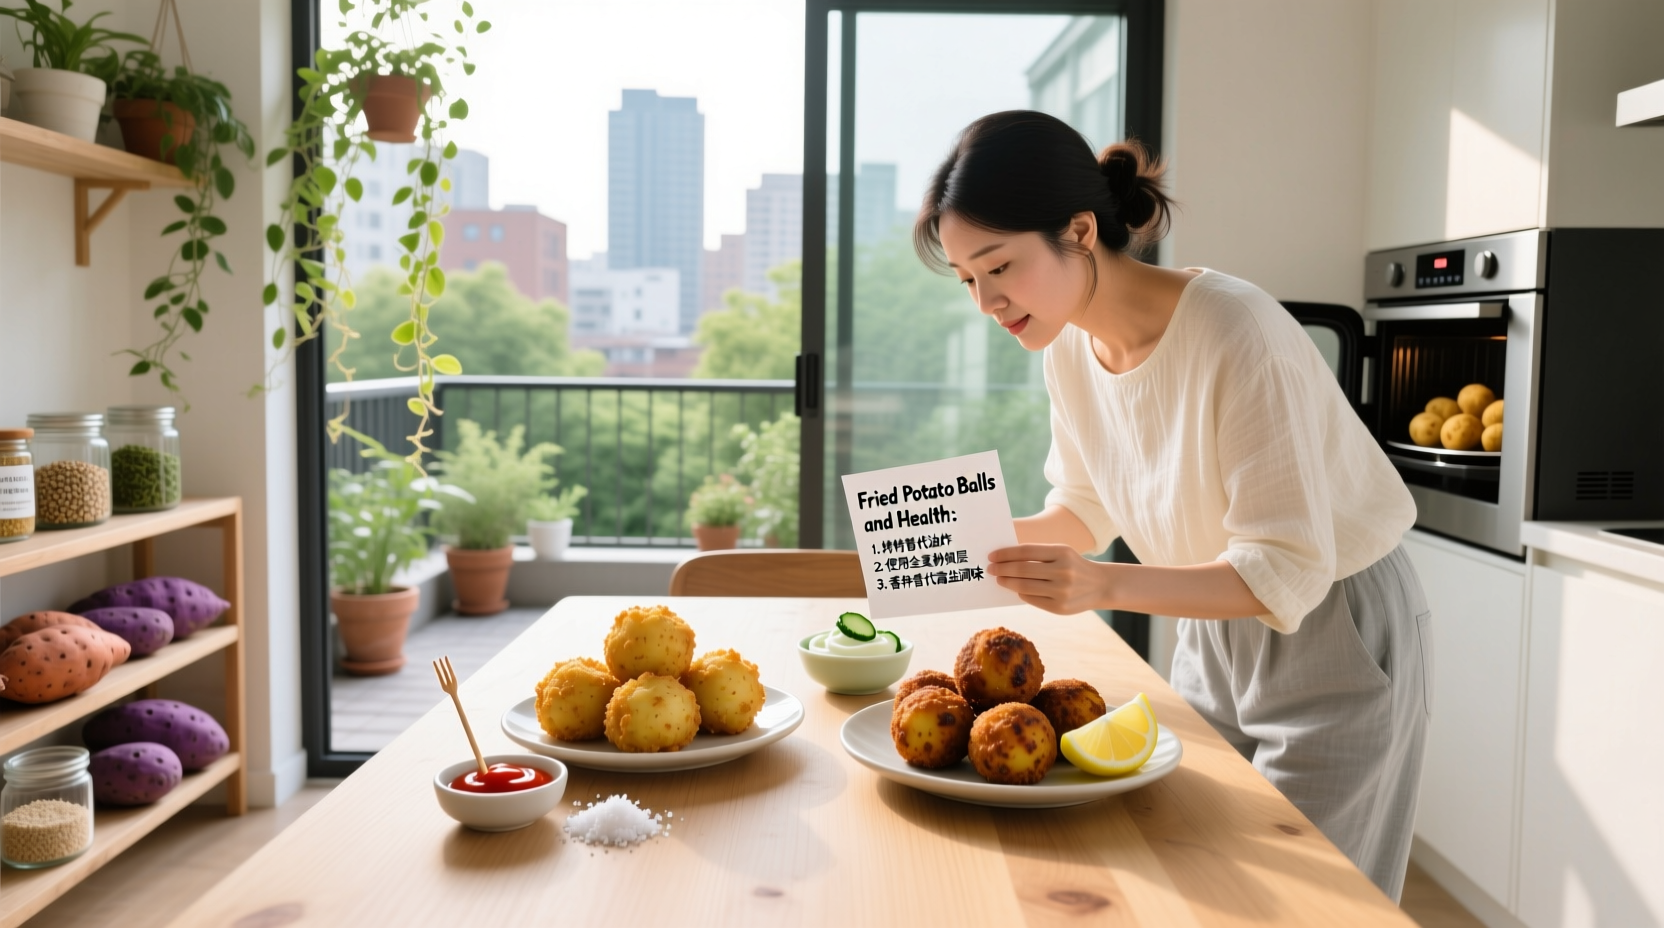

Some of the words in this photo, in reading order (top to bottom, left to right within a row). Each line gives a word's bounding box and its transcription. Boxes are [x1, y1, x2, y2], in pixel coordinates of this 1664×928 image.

[857, 486, 898, 510] Fried
[902, 482, 955, 502] Potato
[956, 471, 996, 495] Balls
[864, 511, 893, 533] and
[896, 504, 958, 528] Health:
